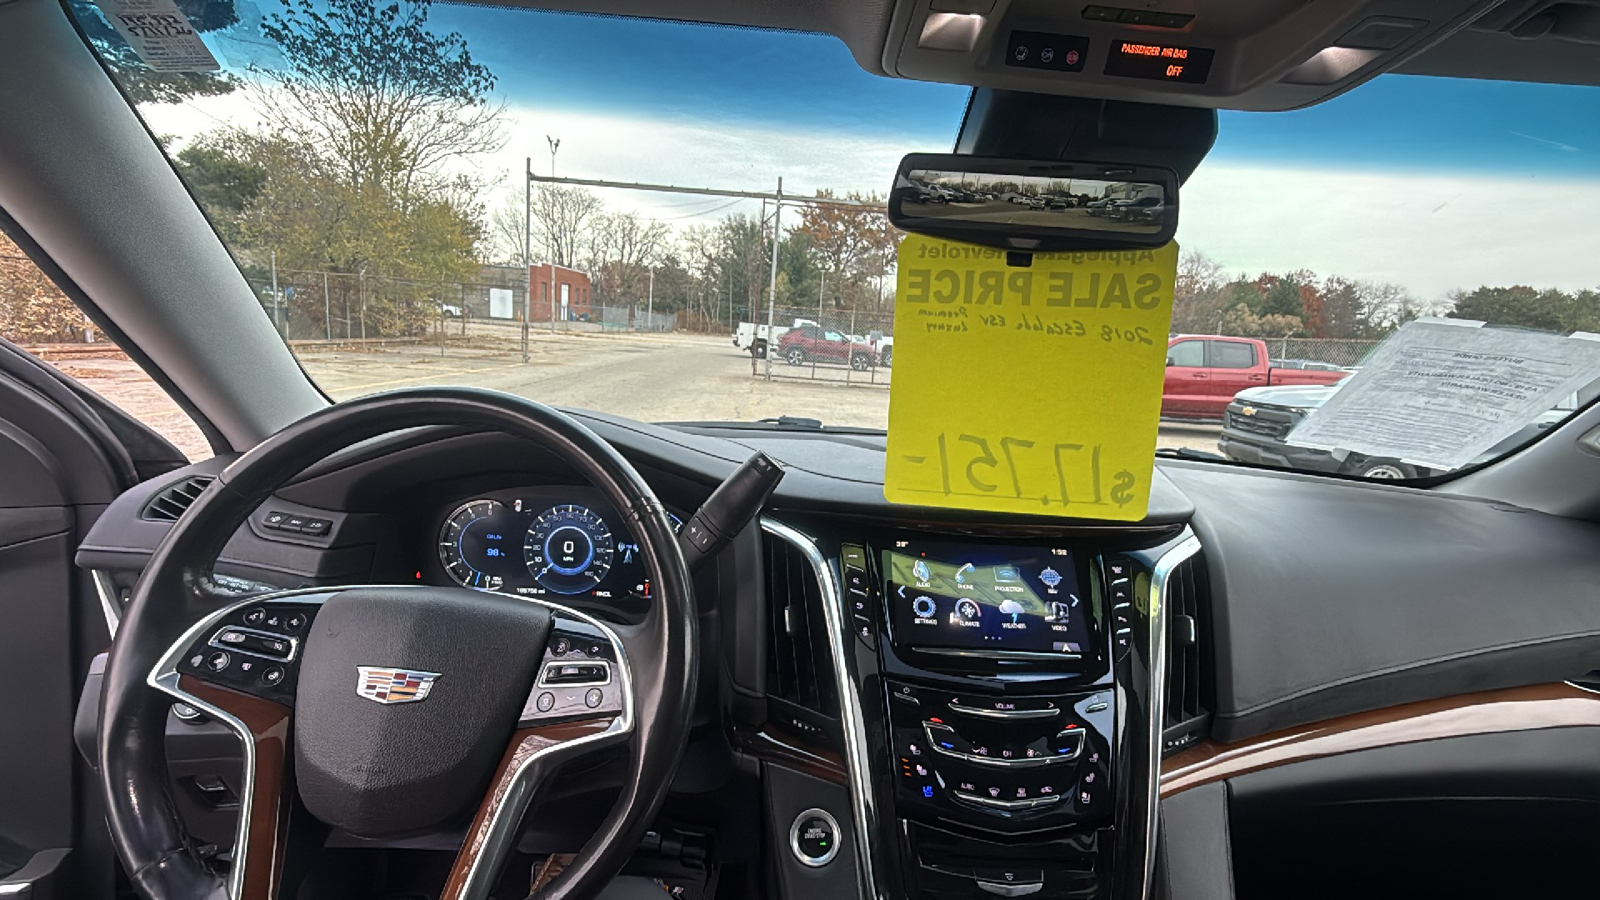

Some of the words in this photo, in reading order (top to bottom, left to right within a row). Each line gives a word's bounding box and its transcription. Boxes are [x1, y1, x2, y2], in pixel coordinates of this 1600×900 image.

[1121, 43, 1160, 56] PASSENGER
[1161, 48, 1173, 58] AIR
[1173, 48, 1188, 59] BAG
[1166, 64, 1183, 77] OFF
[563, 541, 574, 553] 0
[994, 585, 1024, 593] PROJECTION
[914, 617, 937, 626] SETTINGS
[959, 620, 980, 628] CLIMATE
[1002, 622, 1027, 630] WEATHER
[994, 702, 1016, 710] VOLUME
[960, 782, 975, 792] AUTO
